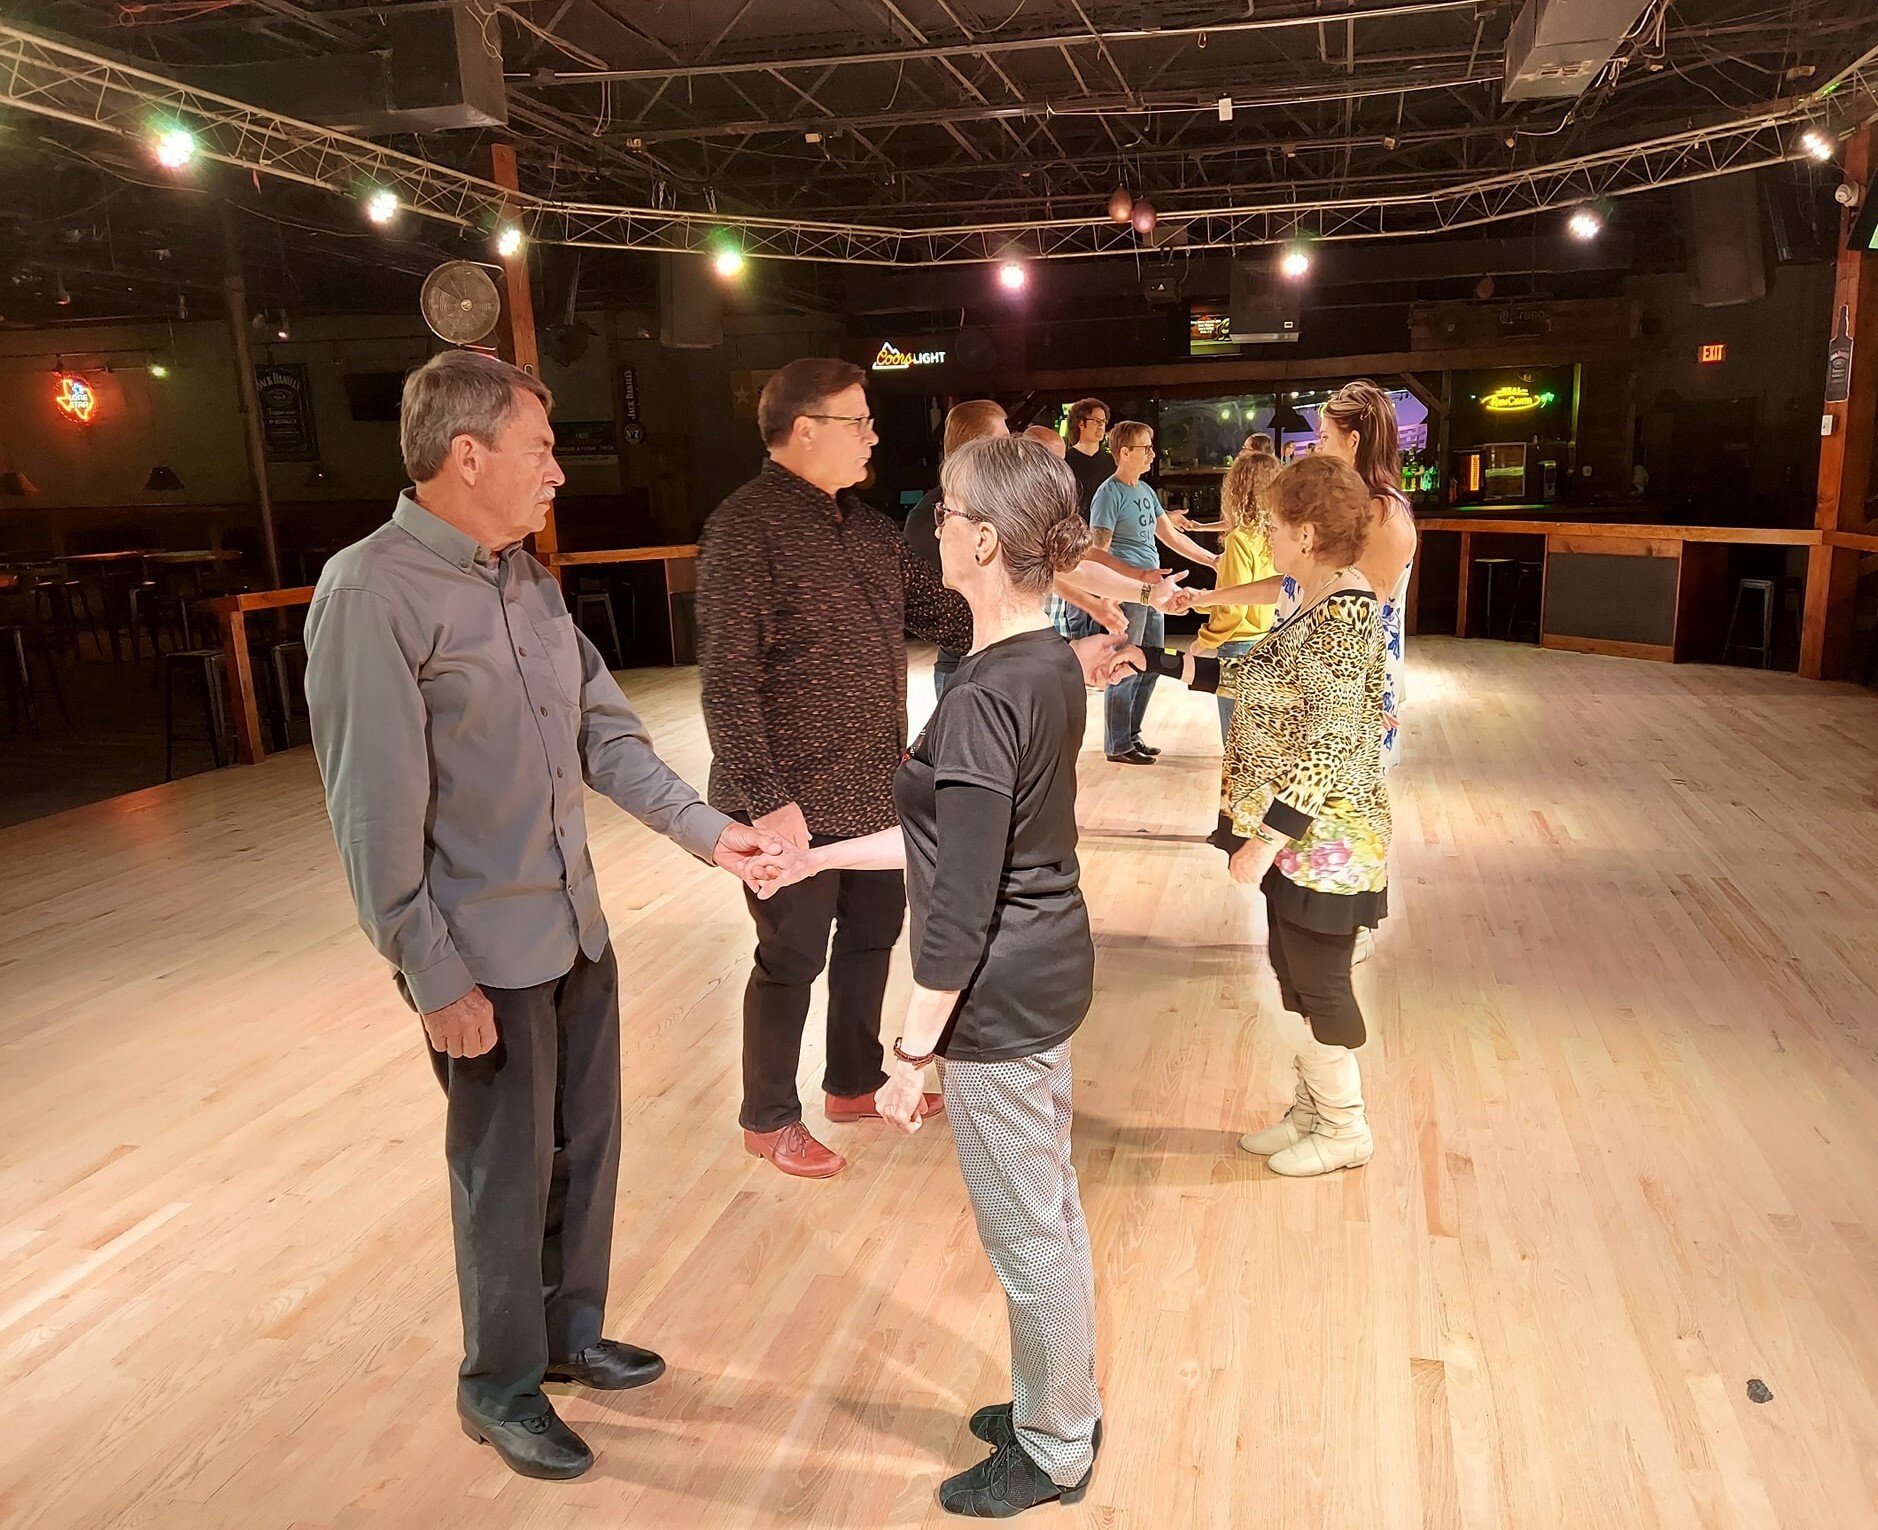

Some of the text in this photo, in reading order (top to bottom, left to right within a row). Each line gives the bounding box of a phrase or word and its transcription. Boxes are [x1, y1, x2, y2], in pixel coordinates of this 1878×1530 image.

[876, 349, 946, 365] Coors LIGHT
[1702, 345, 1724, 361] EXIT
[1133, 497, 1151, 511] YO
[1138, 513, 1155, 527] GA
